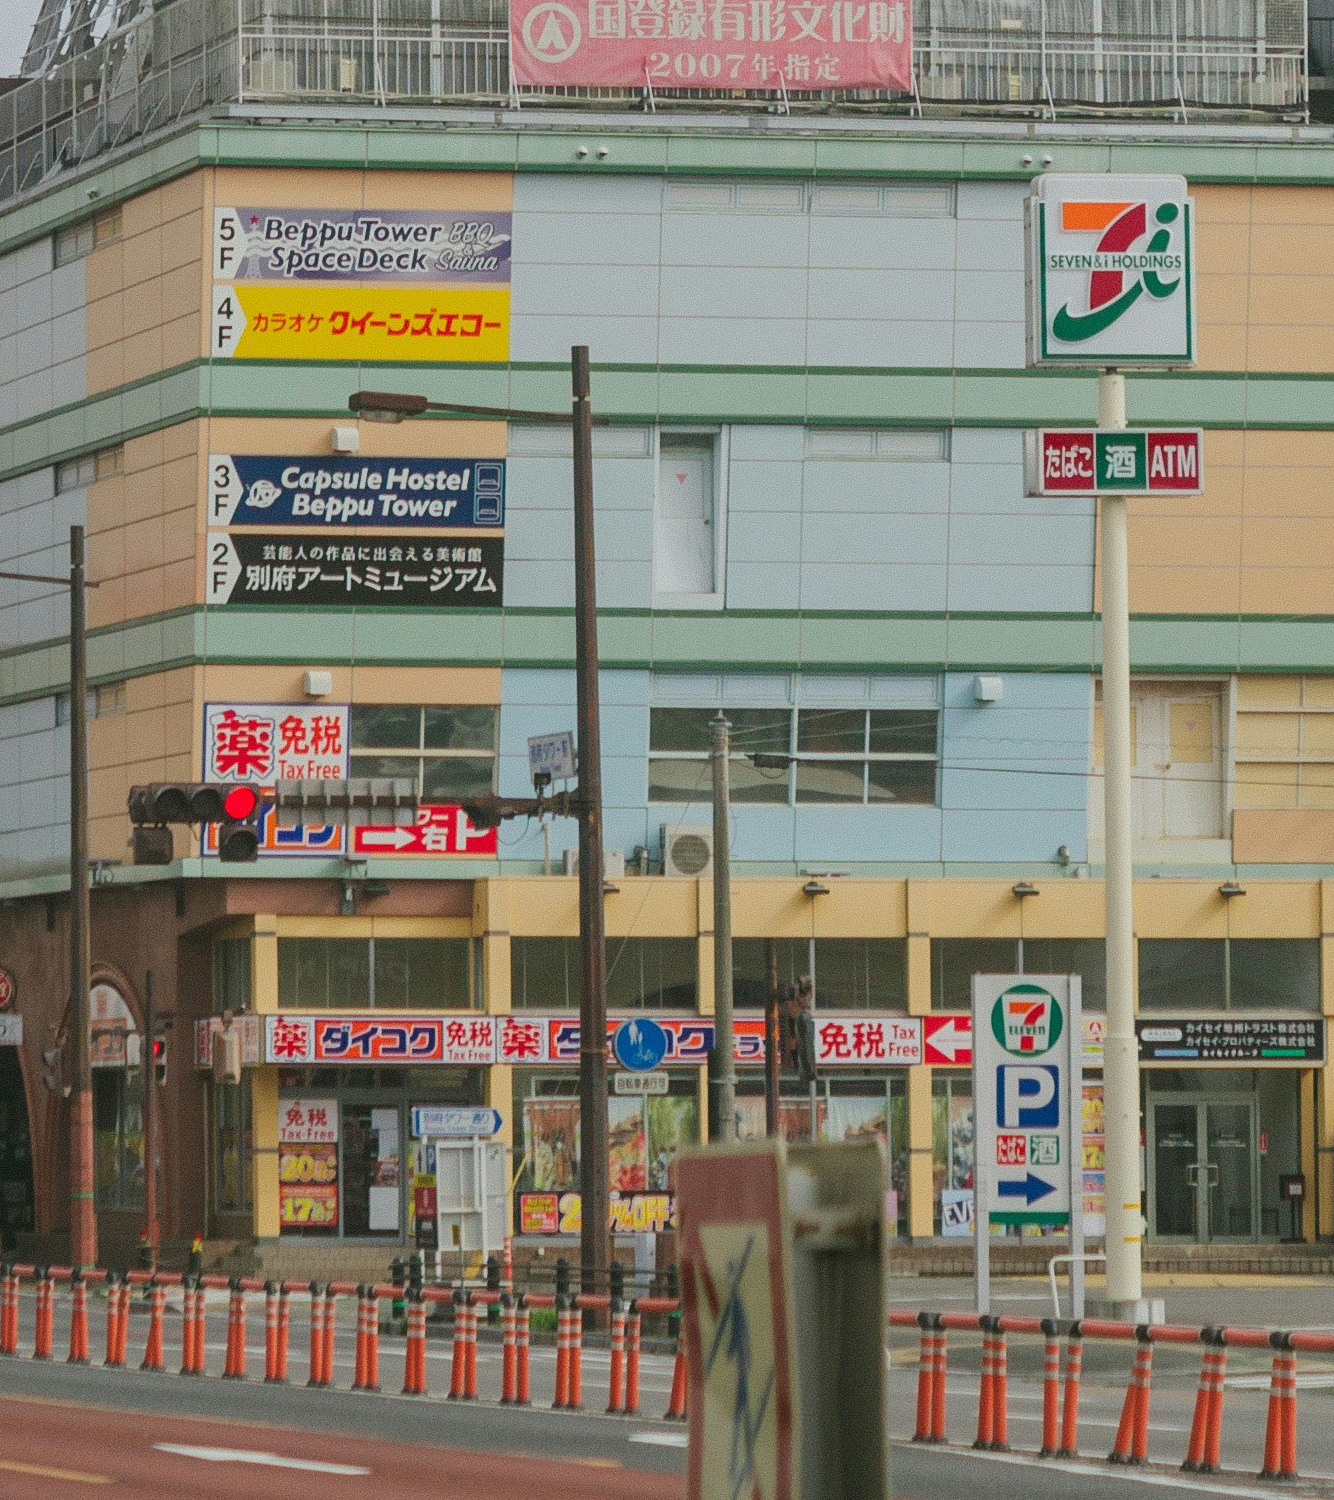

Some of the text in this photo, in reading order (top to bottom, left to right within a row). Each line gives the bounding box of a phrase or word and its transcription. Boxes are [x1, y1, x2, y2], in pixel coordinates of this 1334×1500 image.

[649, 52, 841, 82] 2007年 指定
[265, 218, 442, 248] Beppu Tower
[448, 221, 495, 247] BBQ
[270, 247, 426, 275] Space Deck
[434, 250, 499, 272] Sauna
[1111, 254, 1182, 269] HOLDINGS
[253, 308, 502, 337] カラオケ クイーンズエコー
[1045, 444, 1093, 479] たばこ
[1105, 445, 1137, 479] 酒
[1150, 445, 1197, 478] ATM
[281, 466, 470, 495] Capsule Hostel
[292, 493, 458, 522] Beppu Tower
[263, 545, 483, 563] 芸能人の作品に出会える美術館
[245, 564, 498, 594] 別府アートミュージアム
[215, 710, 272, 777] 薬
[278, 714, 343, 757] 免税
[278, 760, 341, 779] Tax Free
[421, 824, 449, 851] 右
[273, 1018, 308, 1058] 薬
[321, 1024, 437, 1057] ダイコク
[445, 1023, 494, 1049] 免税
[503, 1018, 541, 1058] 薬
[818, 1022, 886, 1060] 免税
[891, 1025, 916, 1041] Tax
[447, 1049, 492, 1061] Tax Free
[888, 1043, 920, 1058] Free
[1003, 1066, 1056, 1127] P
[286, 1104, 327, 1127] 免税
[997, 1137, 1026, 1164] たばこ
[1031, 1137, 1058, 1164] 酒
